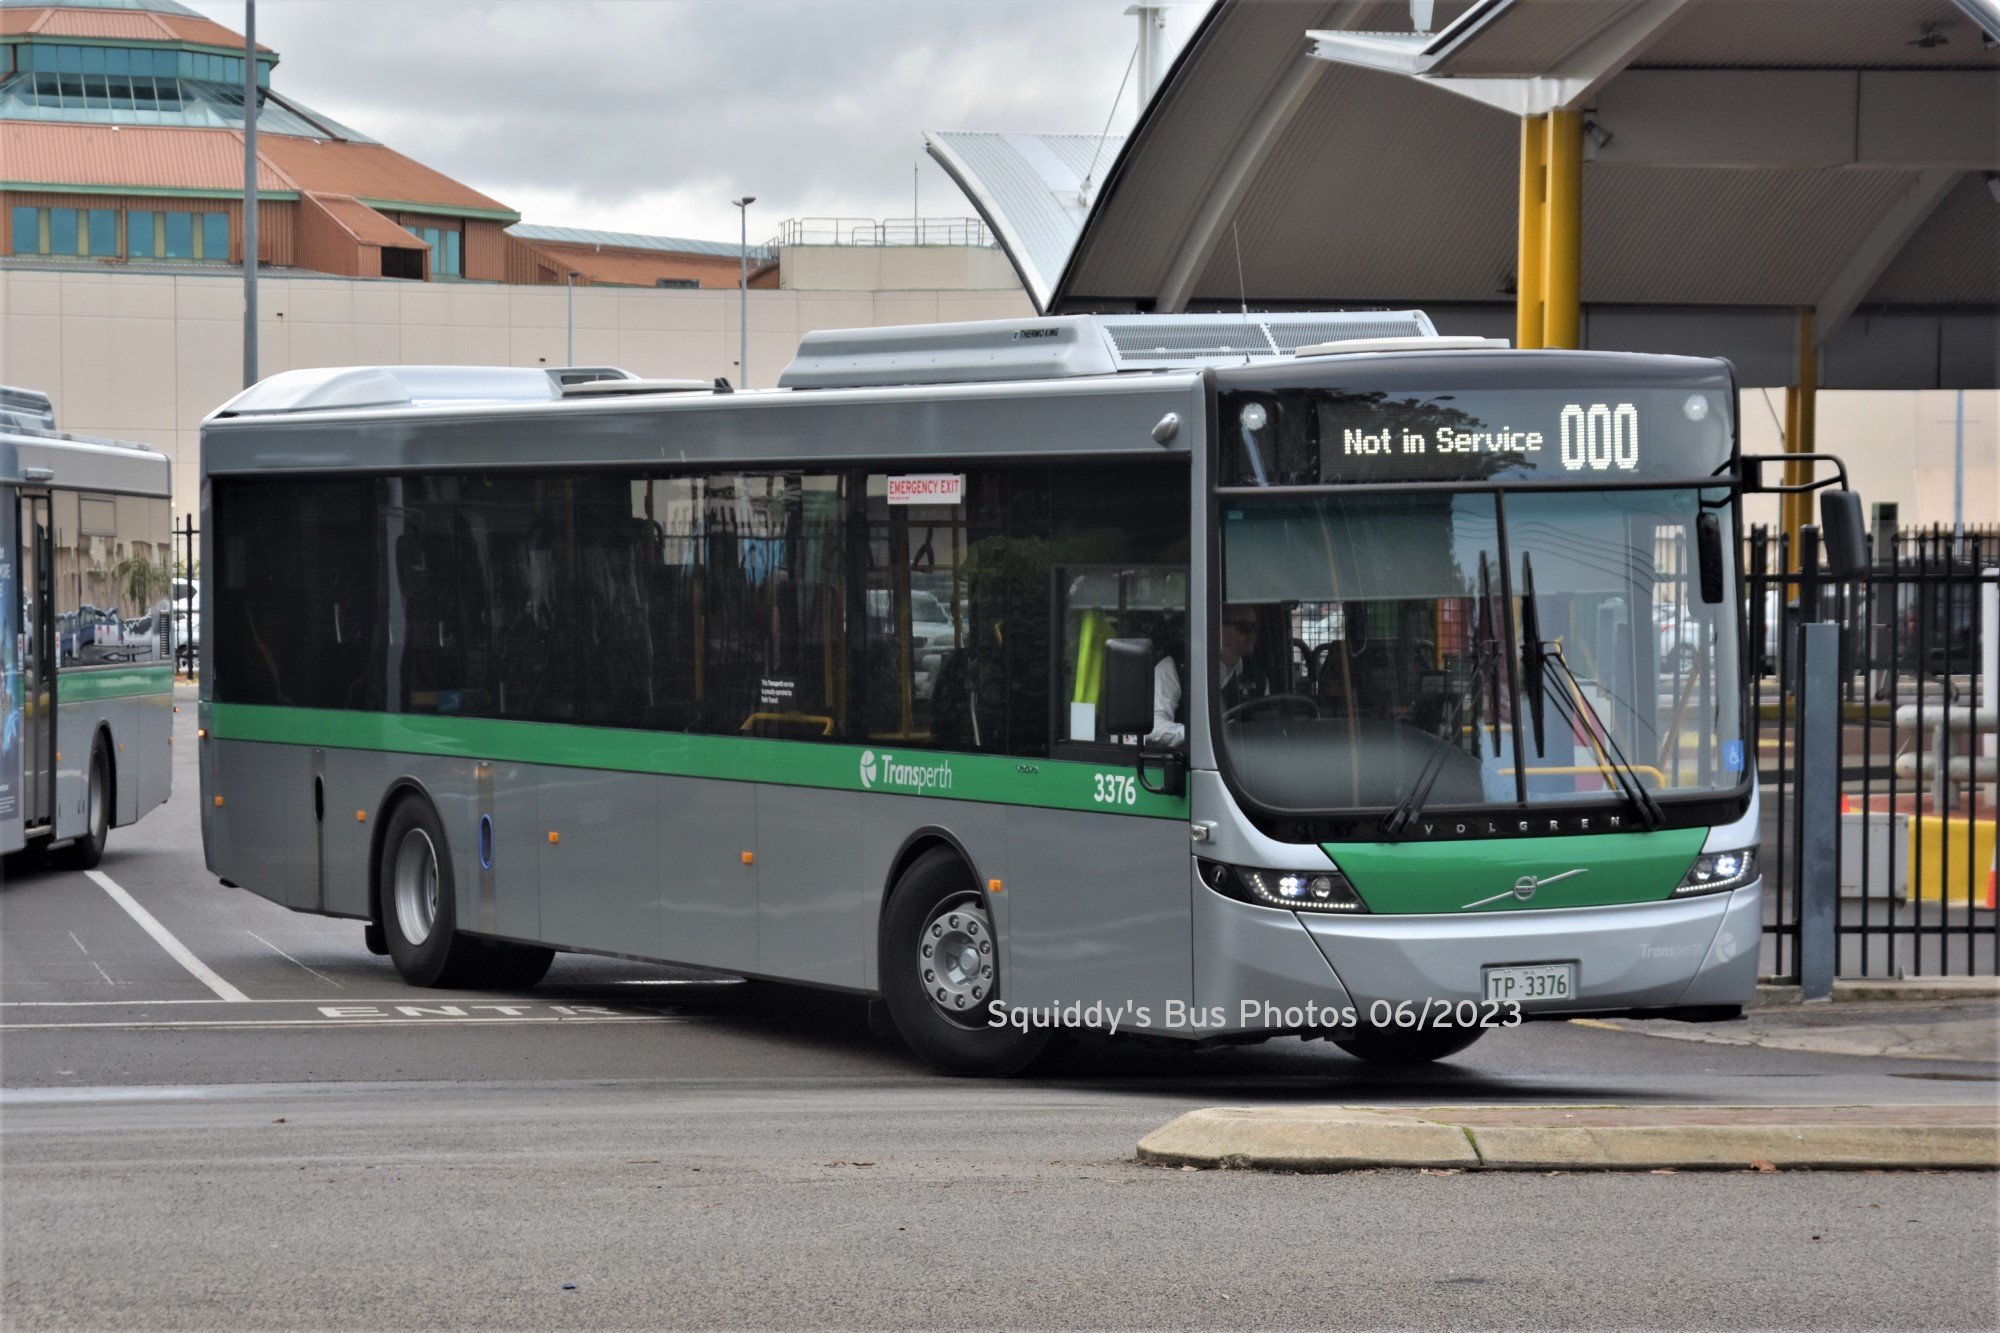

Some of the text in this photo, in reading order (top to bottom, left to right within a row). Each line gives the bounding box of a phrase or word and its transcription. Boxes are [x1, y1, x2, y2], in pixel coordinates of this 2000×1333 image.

[1343, 426, 1544, 454] Not in Service
[1560, 403, 1639, 470] 000
[889, 479, 959, 495] EMERGENCY EXIT
[882, 754, 952, 795] Transperth
[1094, 773, 1136, 805] 3376
[1424, 816, 1620, 835] VOLGREN
[1640, 942, 1704, 960] Transperth
